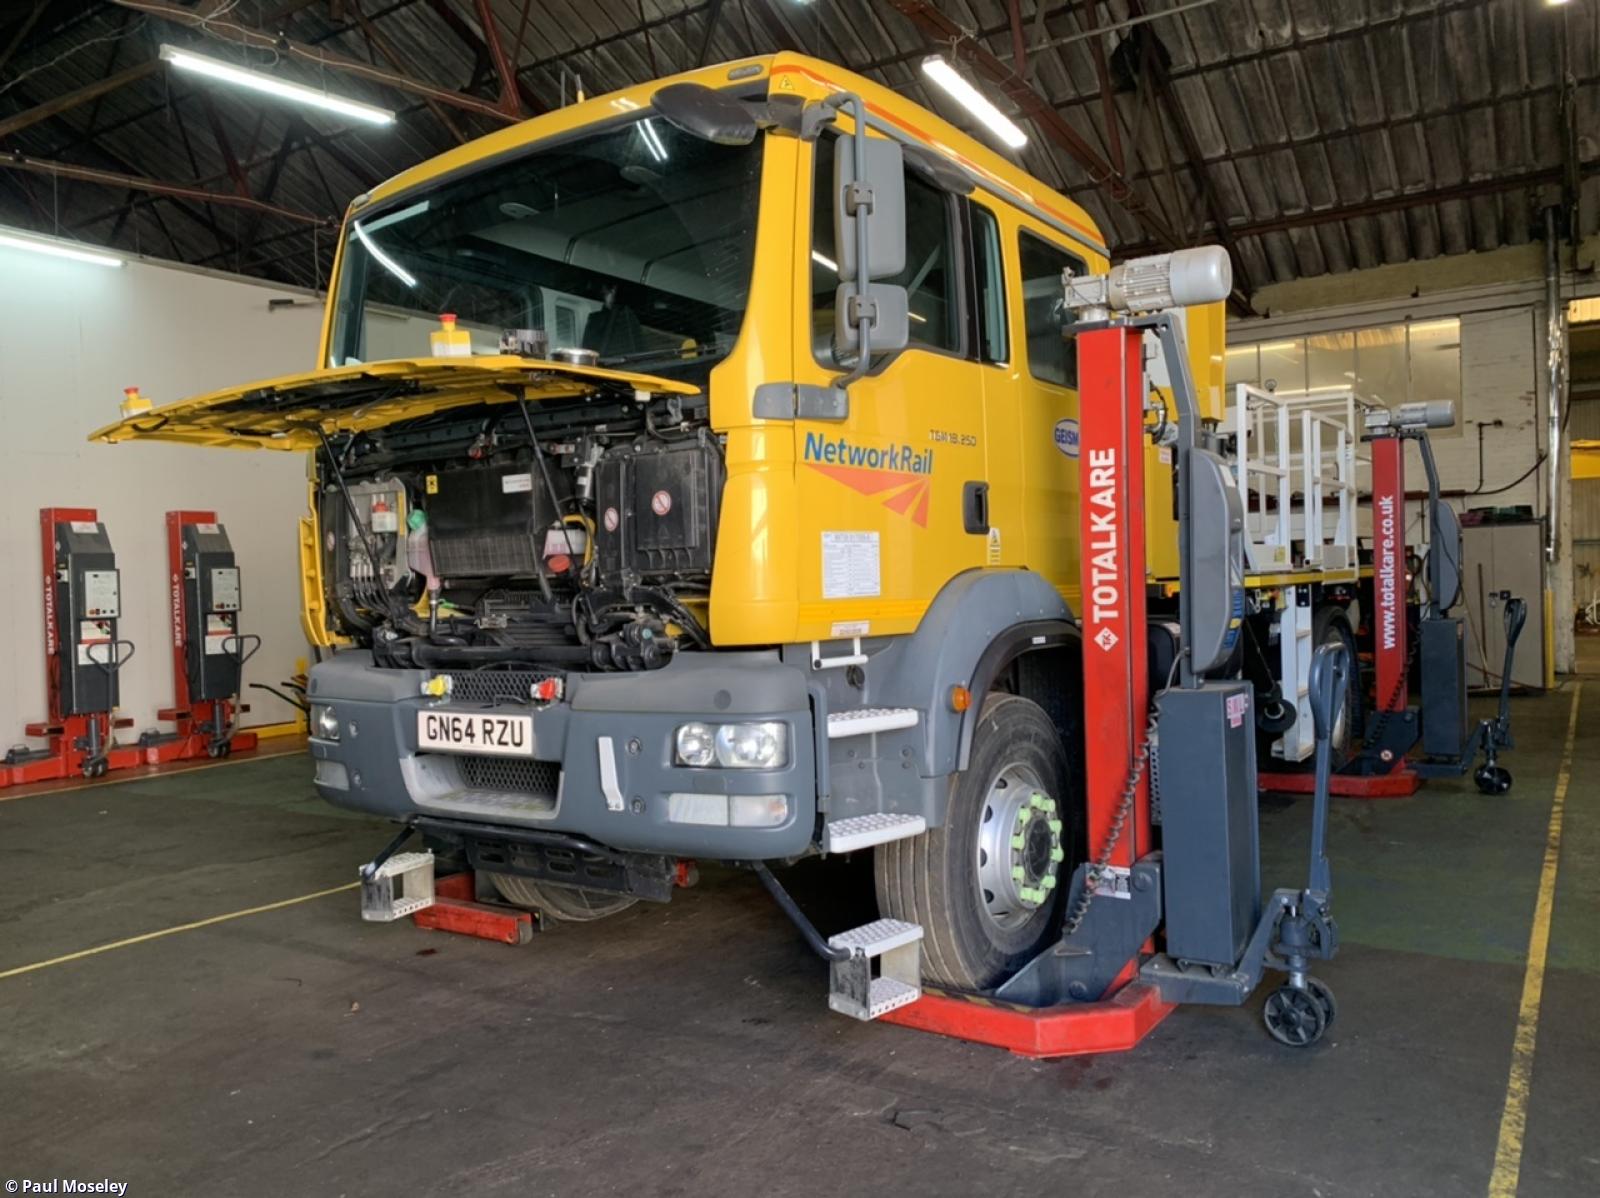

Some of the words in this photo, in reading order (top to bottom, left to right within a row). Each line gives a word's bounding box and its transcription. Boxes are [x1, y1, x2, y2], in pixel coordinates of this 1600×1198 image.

[1055, 427, 1079, 446] GEISM
[1089, 448, 1119, 624] TOTALKARE
[1378, 495, 1396, 650] www.totalkare.co.uk
[45, 586, 55, 655] TOTALKARE
[172, 582, 182, 648] TOTALKARE
[426, 715, 476, 744] GN64
[482, 718, 524, 747] RZU
